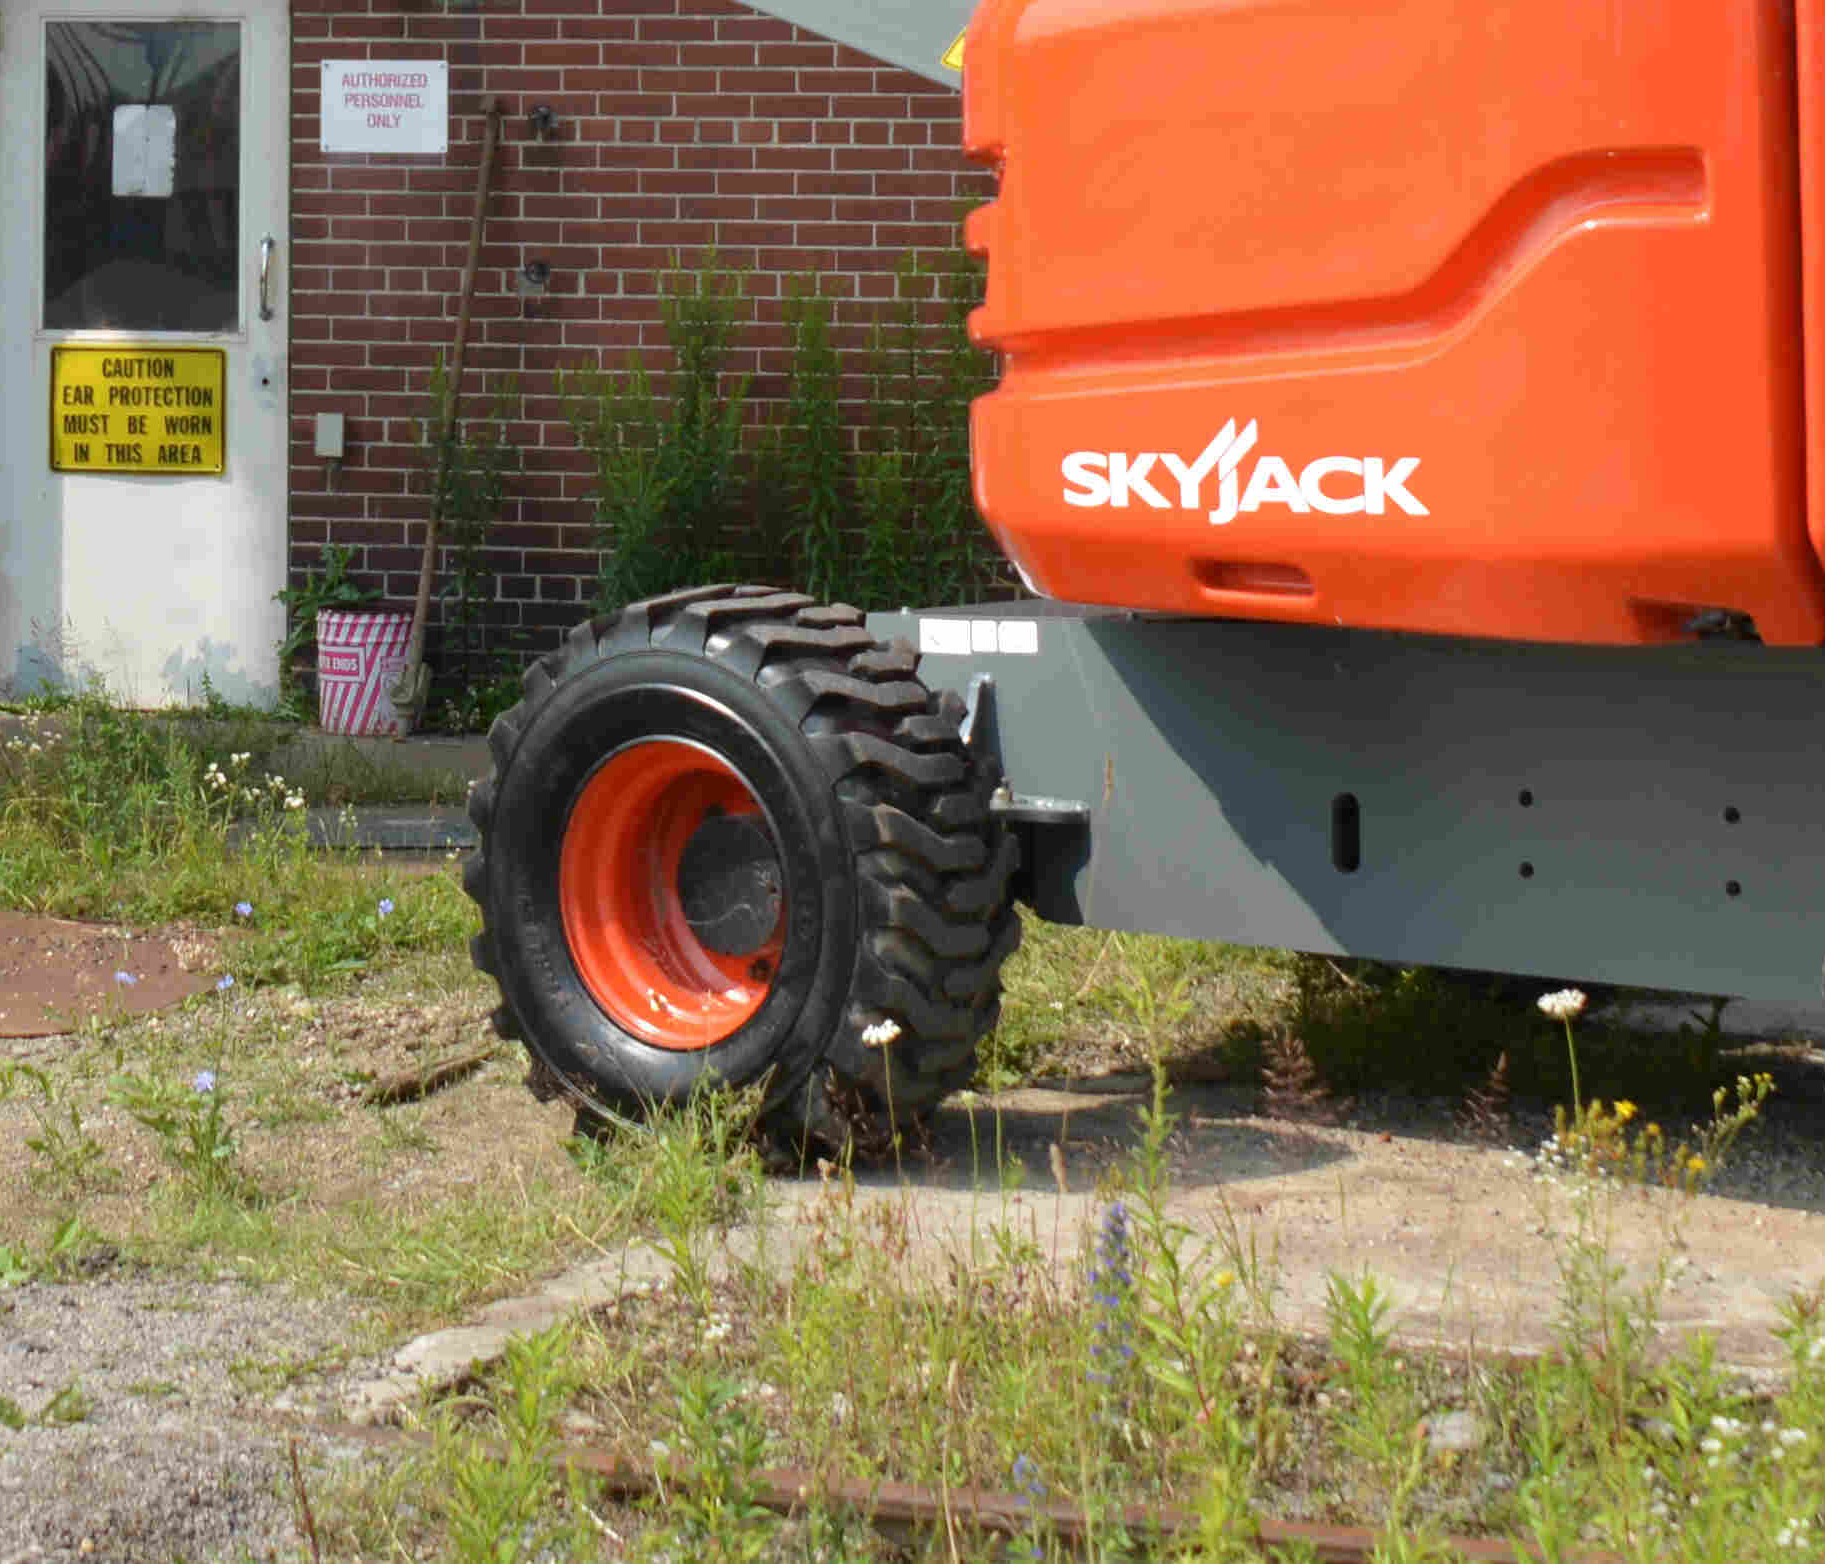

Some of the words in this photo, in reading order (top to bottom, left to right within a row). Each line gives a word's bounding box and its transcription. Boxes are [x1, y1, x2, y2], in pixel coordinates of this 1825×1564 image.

[342, 72, 428, 88] AUTHORIZED
[344, 93, 423, 109] PERSONNEL
[367, 112, 401, 128] ONLY
[102, 358, 174, 378] CAUTION
[63, 385, 94, 406] EAR
[109, 386, 213, 407] PROTECTION
[64, 414, 110, 435] MUST
[128, 415, 147, 435] BE
[165, 415, 212, 435] WORN
[74, 443, 89, 462] IN
[105, 443, 142, 464] THIS
[158, 444, 202, 464] AREA
[1061, 416, 1431, 525] SKYJACK
